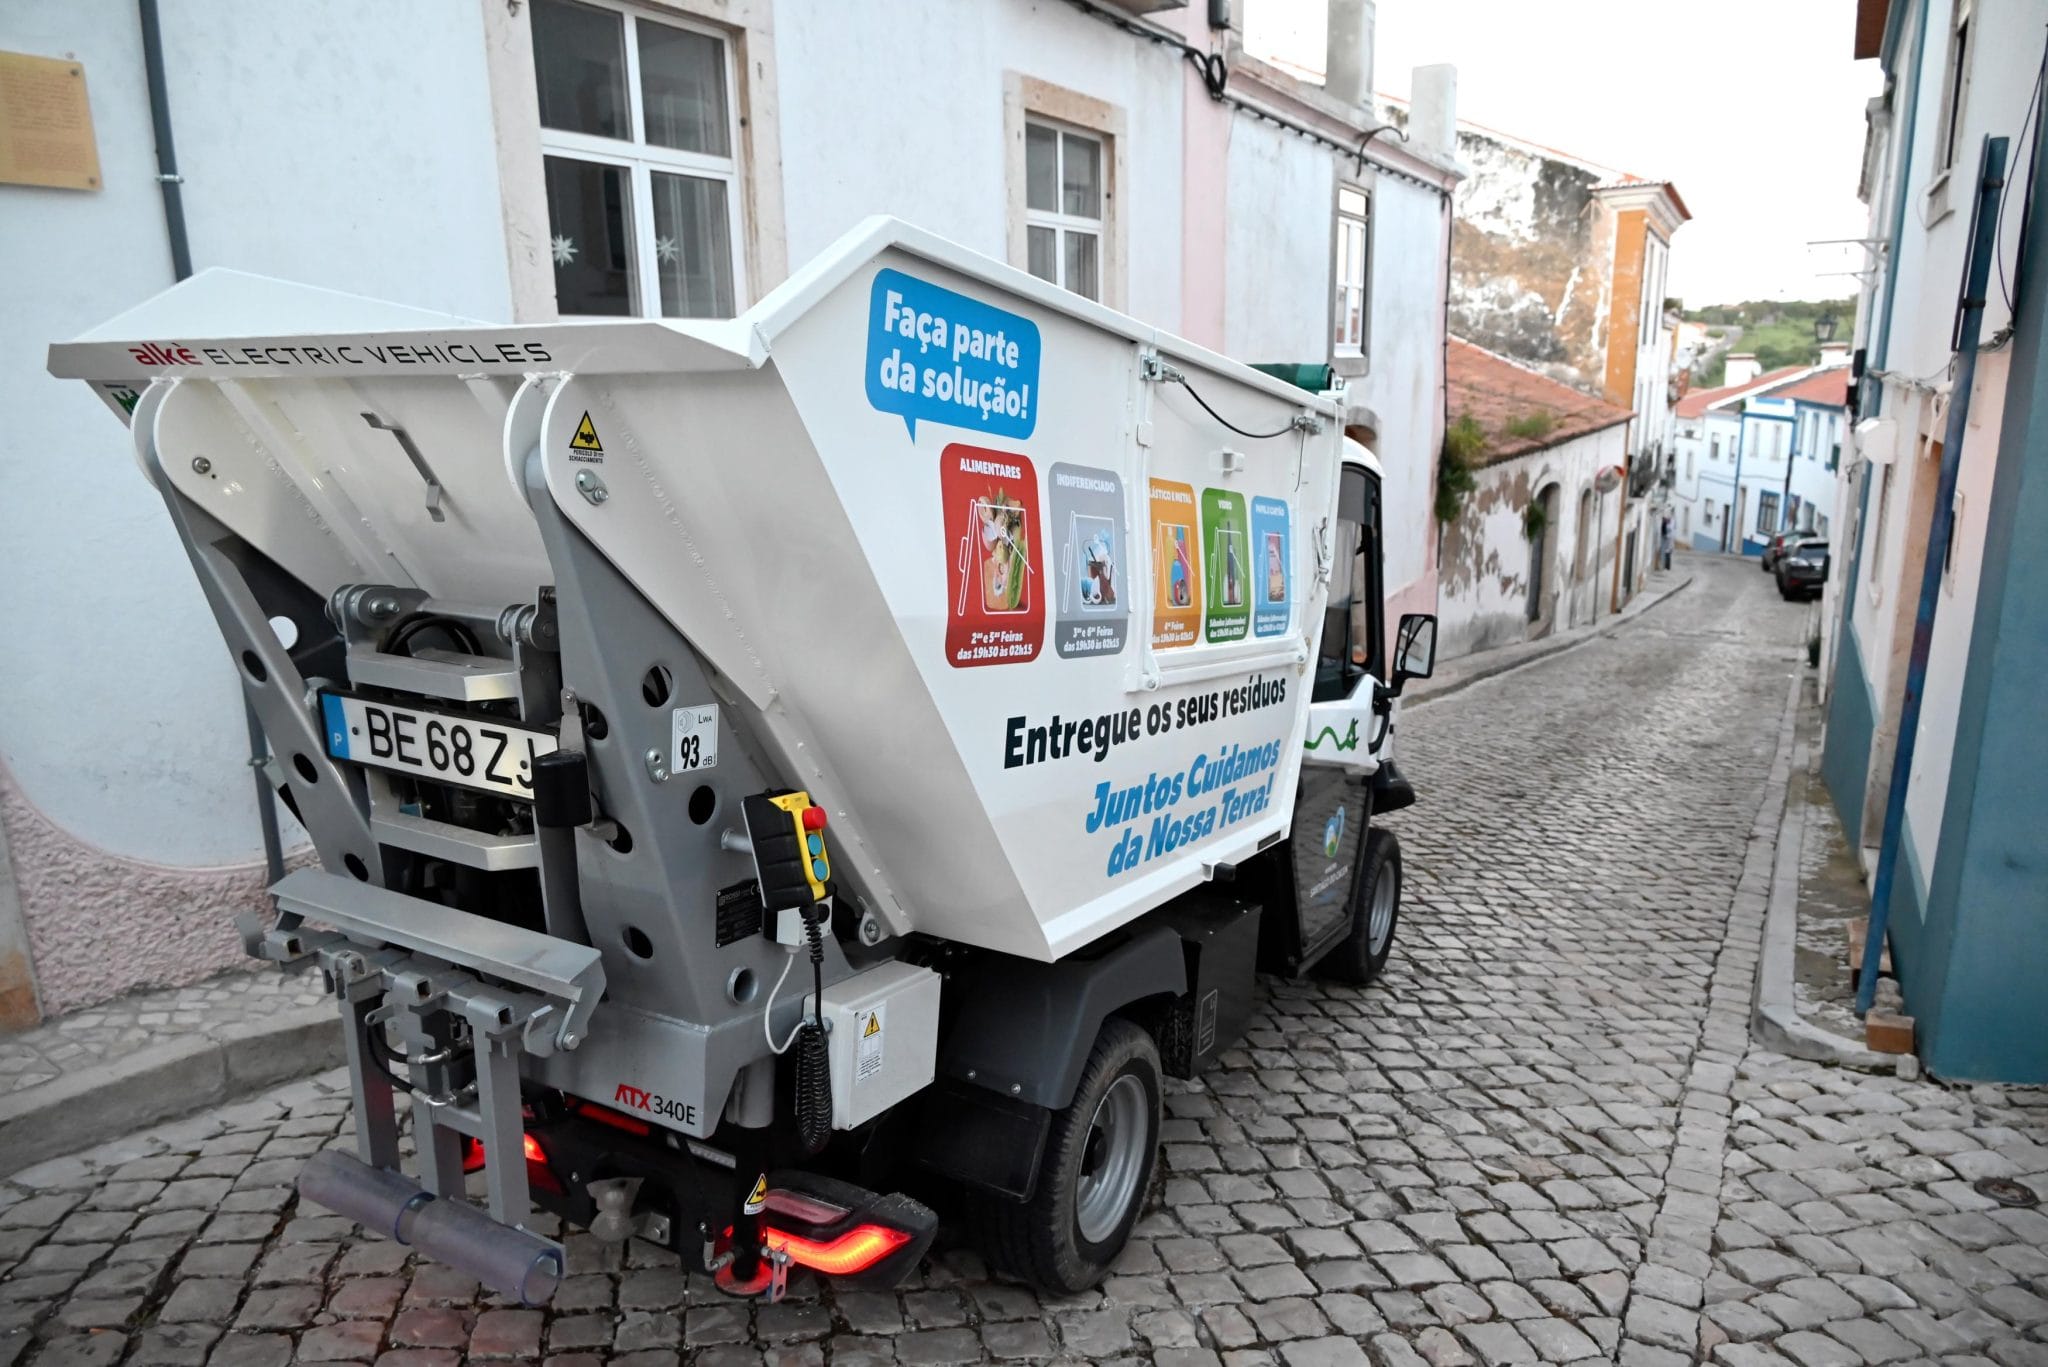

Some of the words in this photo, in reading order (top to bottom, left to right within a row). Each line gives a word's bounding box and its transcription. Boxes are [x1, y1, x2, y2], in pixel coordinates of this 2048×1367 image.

[884, 289, 948, 354] Faça
[953, 322, 1020, 369] parte
[128, 341, 203, 366] alkè
[203, 345, 365, 366] ELECTRIC
[364, 342, 552, 365] VEHICLES
[880, 348, 916, 394] da
[922, 366, 1029, 421] solução!
[959, 457, 1022, 480] ALIMENTARES
[1056, 473, 1116, 493] INDIFERENCIADO
[982, 634, 989, 644] e
[1000, 630, 1024, 643] Feiras
[1096, 625, 1114, 637] Feiras
[957, 648, 972, 660] das
[972, 646, 999, 659] 19h30
[999, 645, 1009, 657] às
[1009, 643, 1033, 657] 02h15
[1063, 641, 1075, 652] das
[1003, 707, 1142, 769] Entregue
[1147, 700, 1172, 736] os
[1176, 692, 1219, 730] seus
[1222, 674, 1286, 718] resíduos
[333, 732, 343, 747] P
[680, 734, 700, 770] 93
[702, 755, 713, 766] dB
[1085, 771, 1185, 834] Juntos
[1187, 738, 1281, 798] Cuidamos
[1107, 827, 1143, 878] da
[1144, 805, 1217, 862] Nossa
[1219, 772, 1276, 829] Terra!
[614, 1083, 652, 1112] ATX
[653, 1095, 696, 1126] 340E
